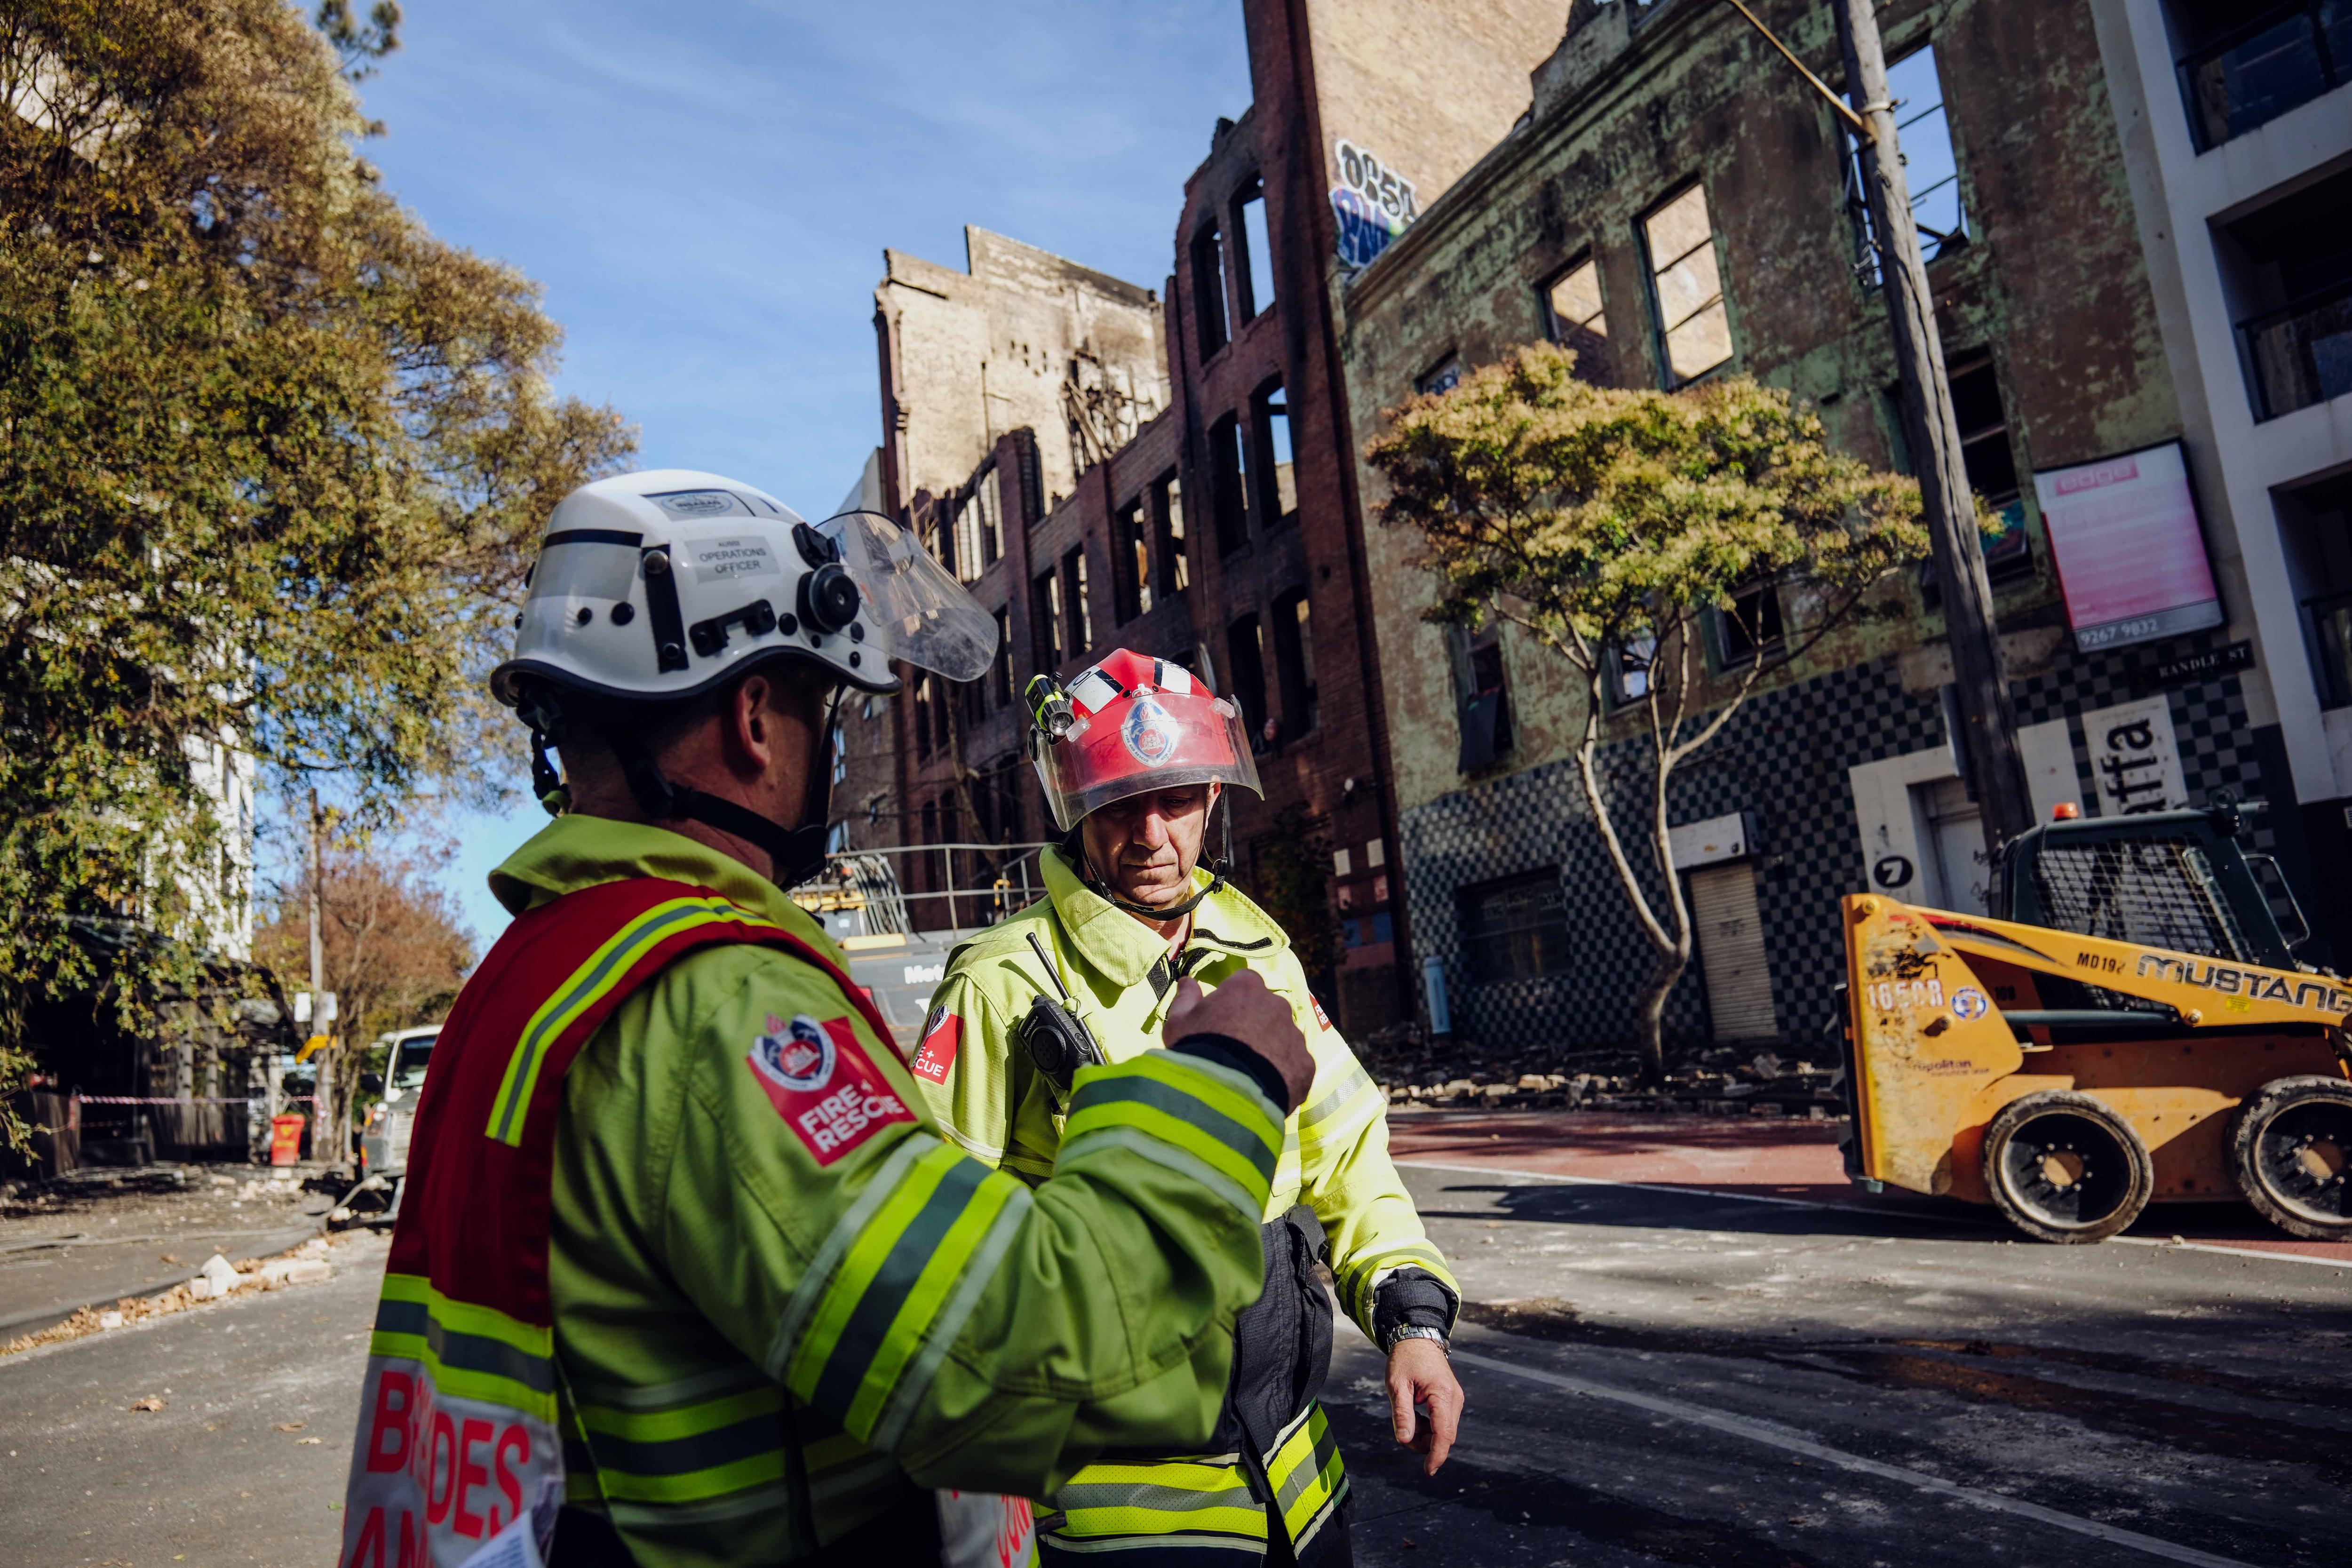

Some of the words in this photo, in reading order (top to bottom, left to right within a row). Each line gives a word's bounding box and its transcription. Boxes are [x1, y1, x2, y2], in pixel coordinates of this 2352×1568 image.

[699, 548, 766, 562] OPERATIONS
[715, 560, 761, 574] OFFICER
[2080, 624, 2117, 645] 9267
[1135, 751, 1149, 763] RESCUE
[1882, 860, 1903, 885] 7
[2135, 953, 2352, 1016] MUSTANG
[1024, 1015, 1039, 1037] MOTOROLA
[800, 1083, 863, 1134] FIRE
